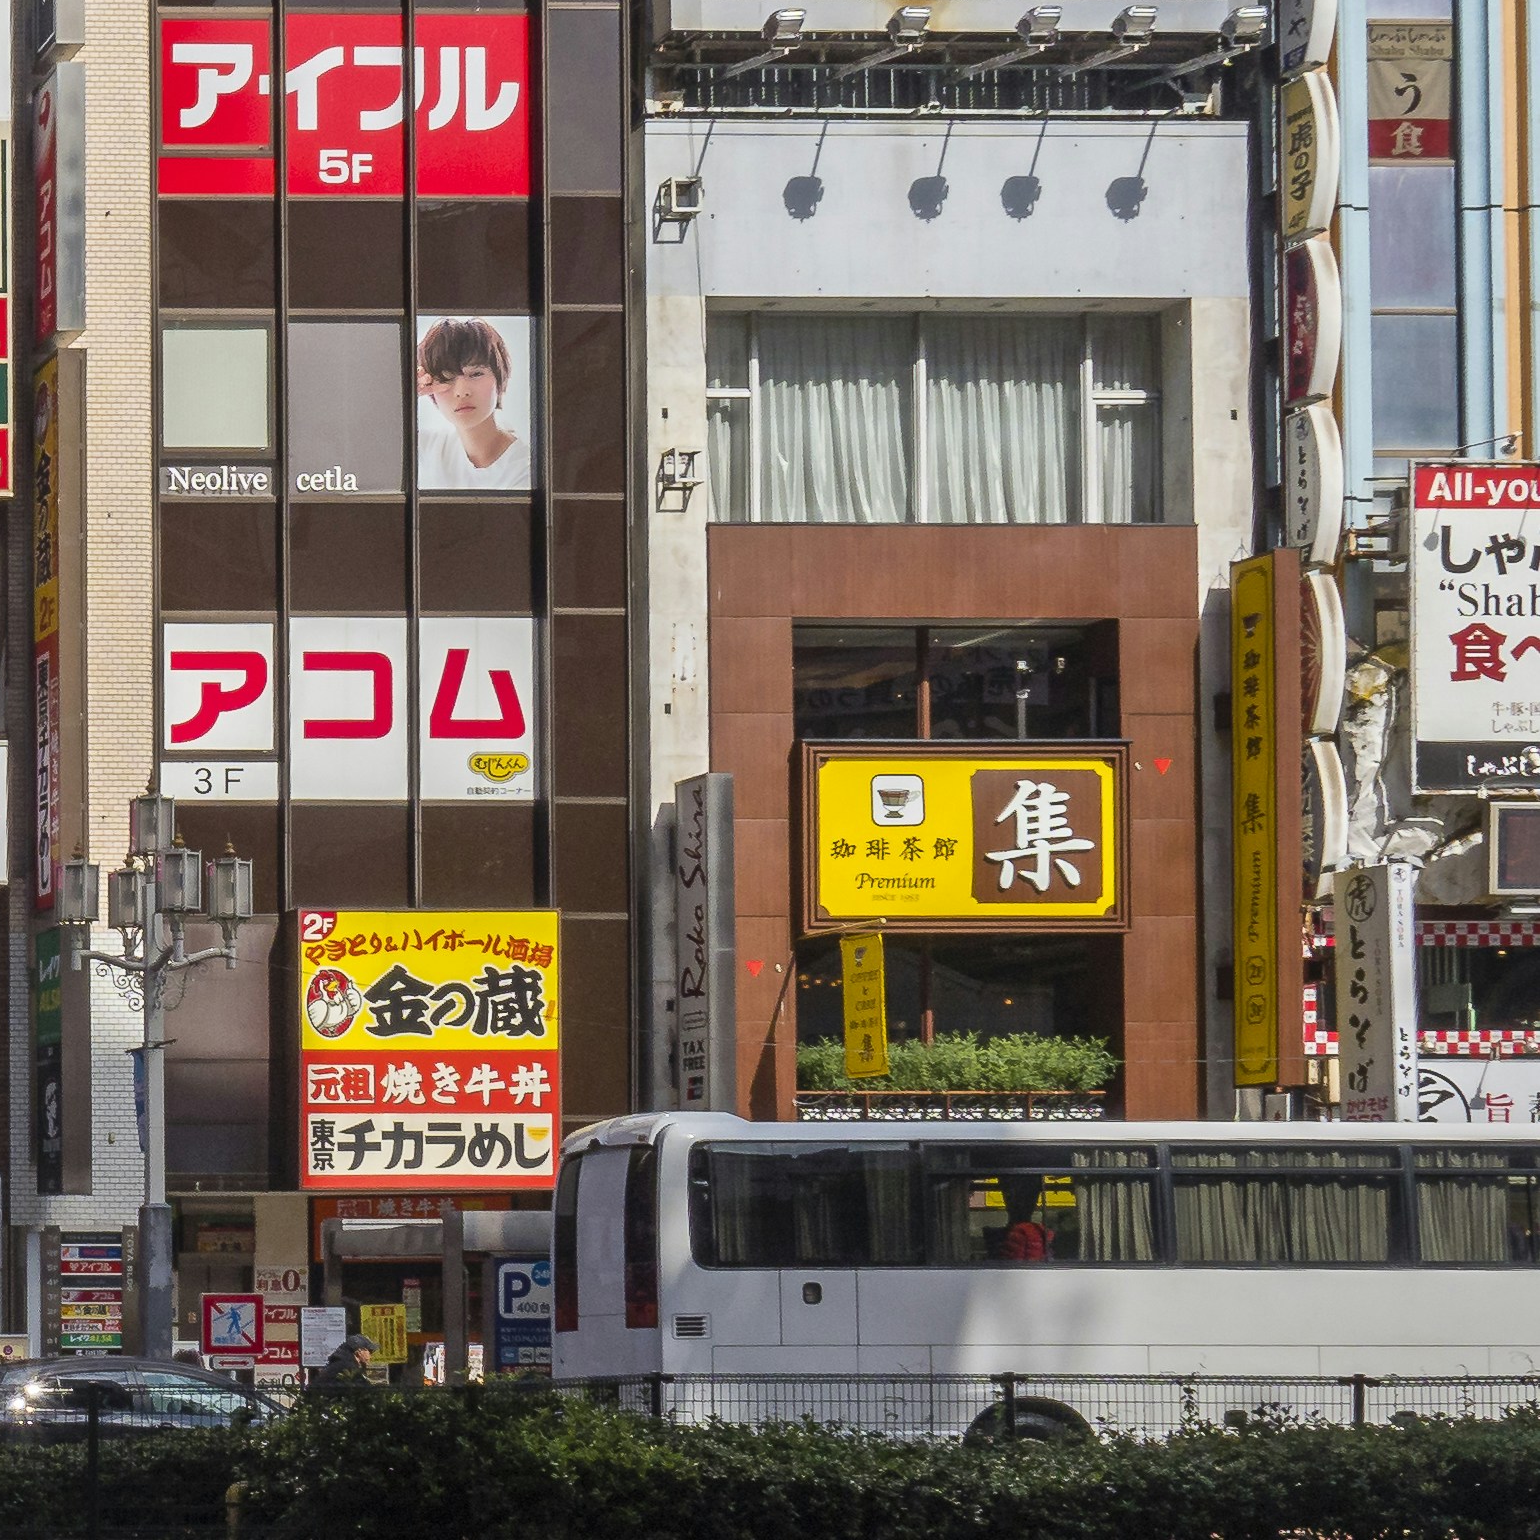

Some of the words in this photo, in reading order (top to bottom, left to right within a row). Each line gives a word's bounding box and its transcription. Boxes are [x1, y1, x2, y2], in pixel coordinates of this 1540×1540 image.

[171, 42, 521, 133] アイフル
[1390, 122, 1425, 157] 食
[318, 149, 374, 185] 5F
[167, 465, 269, 494] Neolive
[295, 465, 359, 494] cetla
[168, 647, 526, 743] アコム
[1239, 649, 1263, 763] 珈琲茶館
[984, 778, 1096, 894] 集
[1239, 791, 1266, 837] 集
[830, 837, 958, 861] 珈琲茶館
[854, 872, 937, 892] Premium
[304, 927, 556, 969] やきとり&ハイボール酒場
[363, 964, 546, 1038] 金の蔵
[1348, 924, 1372, 1094] とらそば
[308, 1065, 374, 1103] 元祖
[379, 1061, 552, 1108] 焼き牛丼
[309, 1118, 336, 1171] 東京
[337, 1118, 551, 1171] チカラめし
